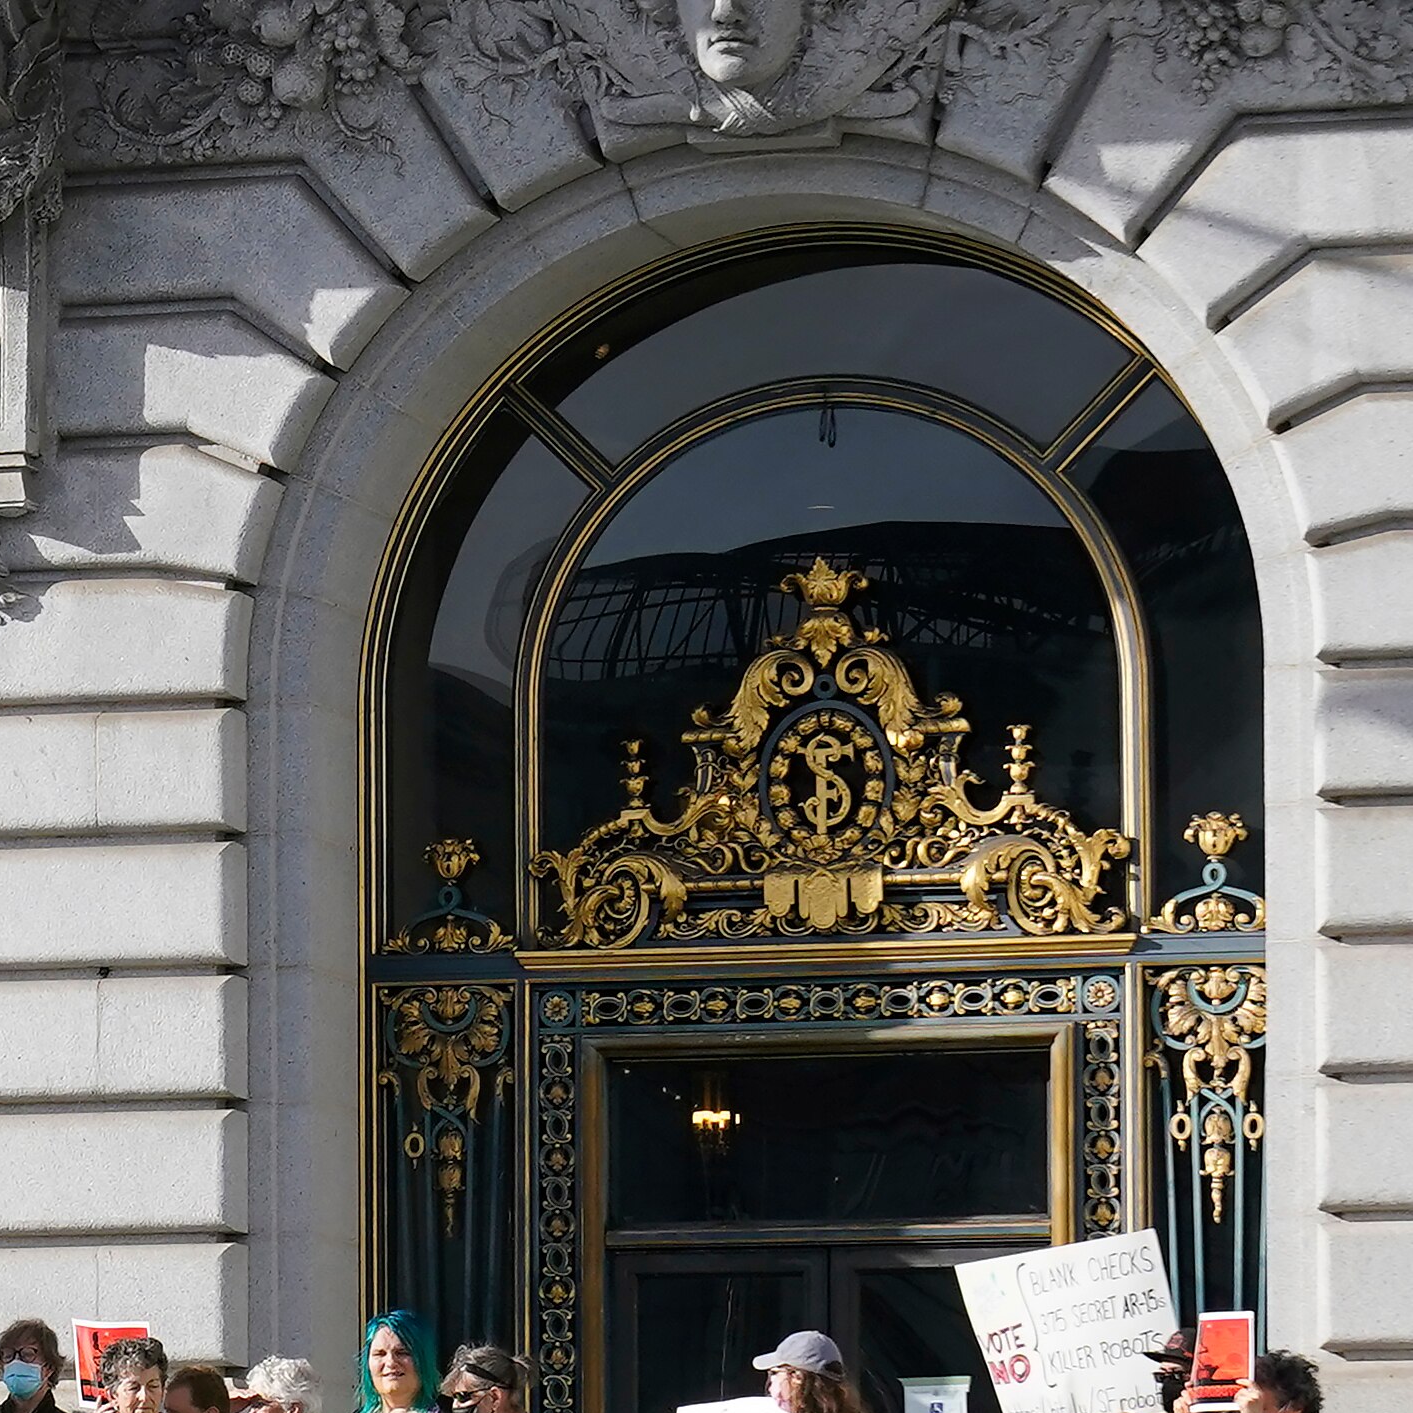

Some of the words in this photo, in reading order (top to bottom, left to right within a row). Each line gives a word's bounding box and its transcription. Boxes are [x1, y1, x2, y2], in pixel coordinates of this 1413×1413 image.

[1029, 1262, 1080, 1296] BLANK
[1087, 1246, 1154, 1282] CHECKS
[1073, 1295, 1118, 1328] SECRET
[977, 1322, 1025, 1355] VOTE
[1047, 1342, 1097, 1375] KILLER
[1100, 1329, 1166, 1366] ROBOTS
[987, 1353, 1032, 1386] NO
